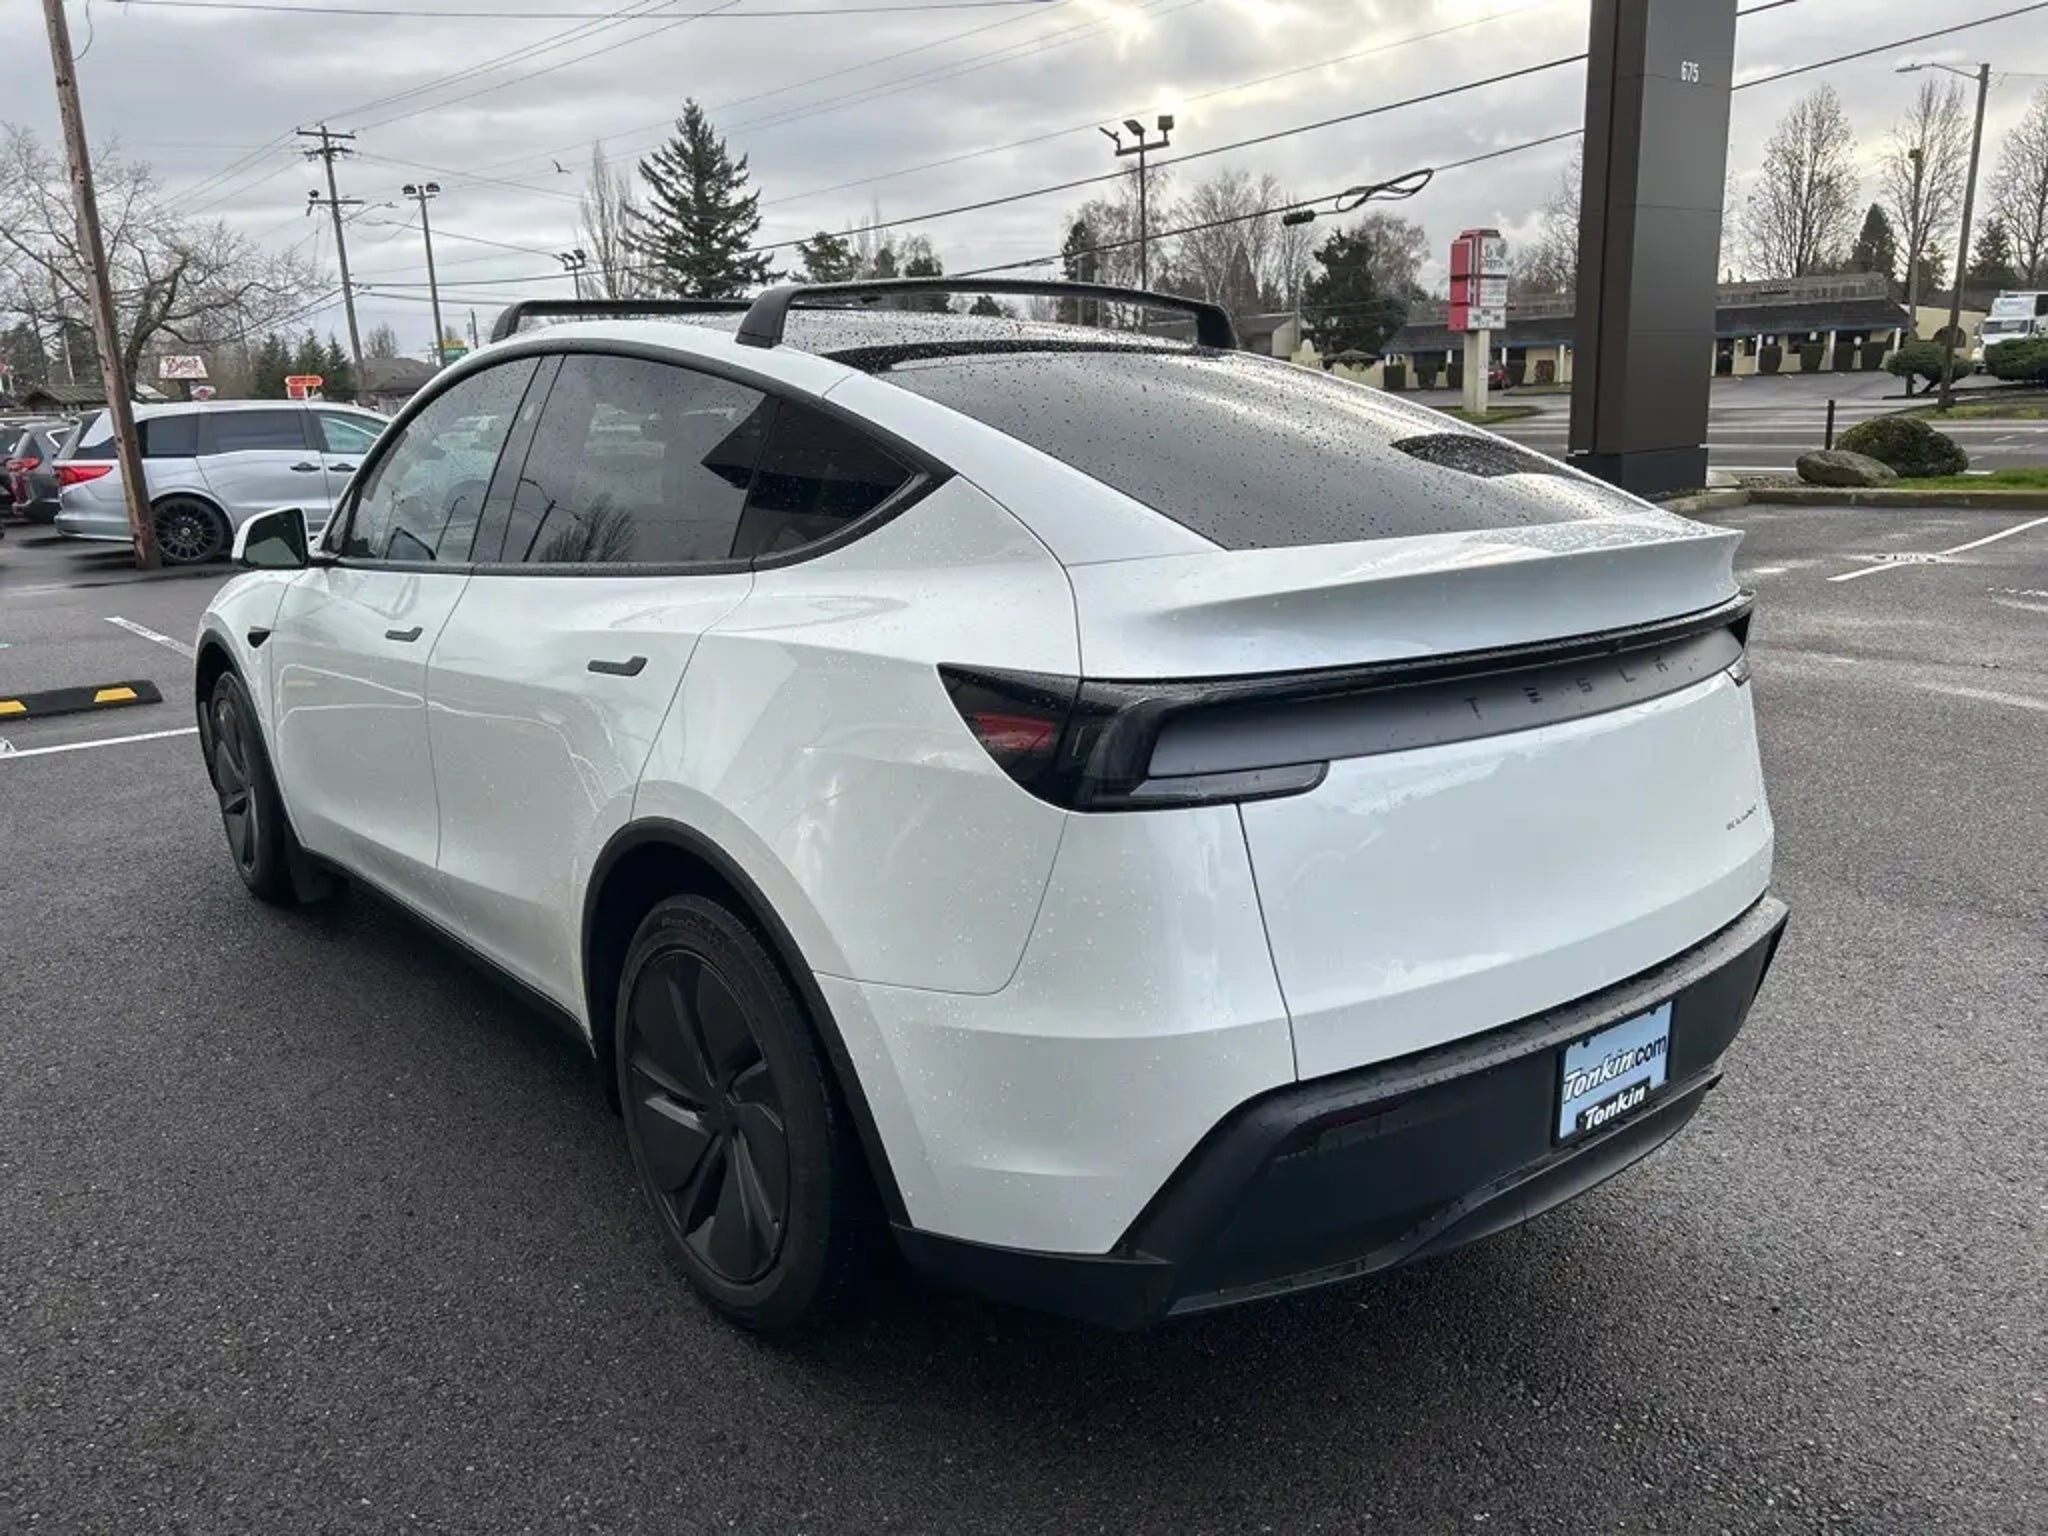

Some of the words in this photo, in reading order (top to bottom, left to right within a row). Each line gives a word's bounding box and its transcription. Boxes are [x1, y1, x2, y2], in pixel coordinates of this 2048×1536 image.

[1681, 60, 1699, 83] 675
[1464, 655, 1669, 720] TESLA
[1563, 1035, 1666, 1104] Tonkin.com
[1585, 1085, 1645, 1130] Tonkin
